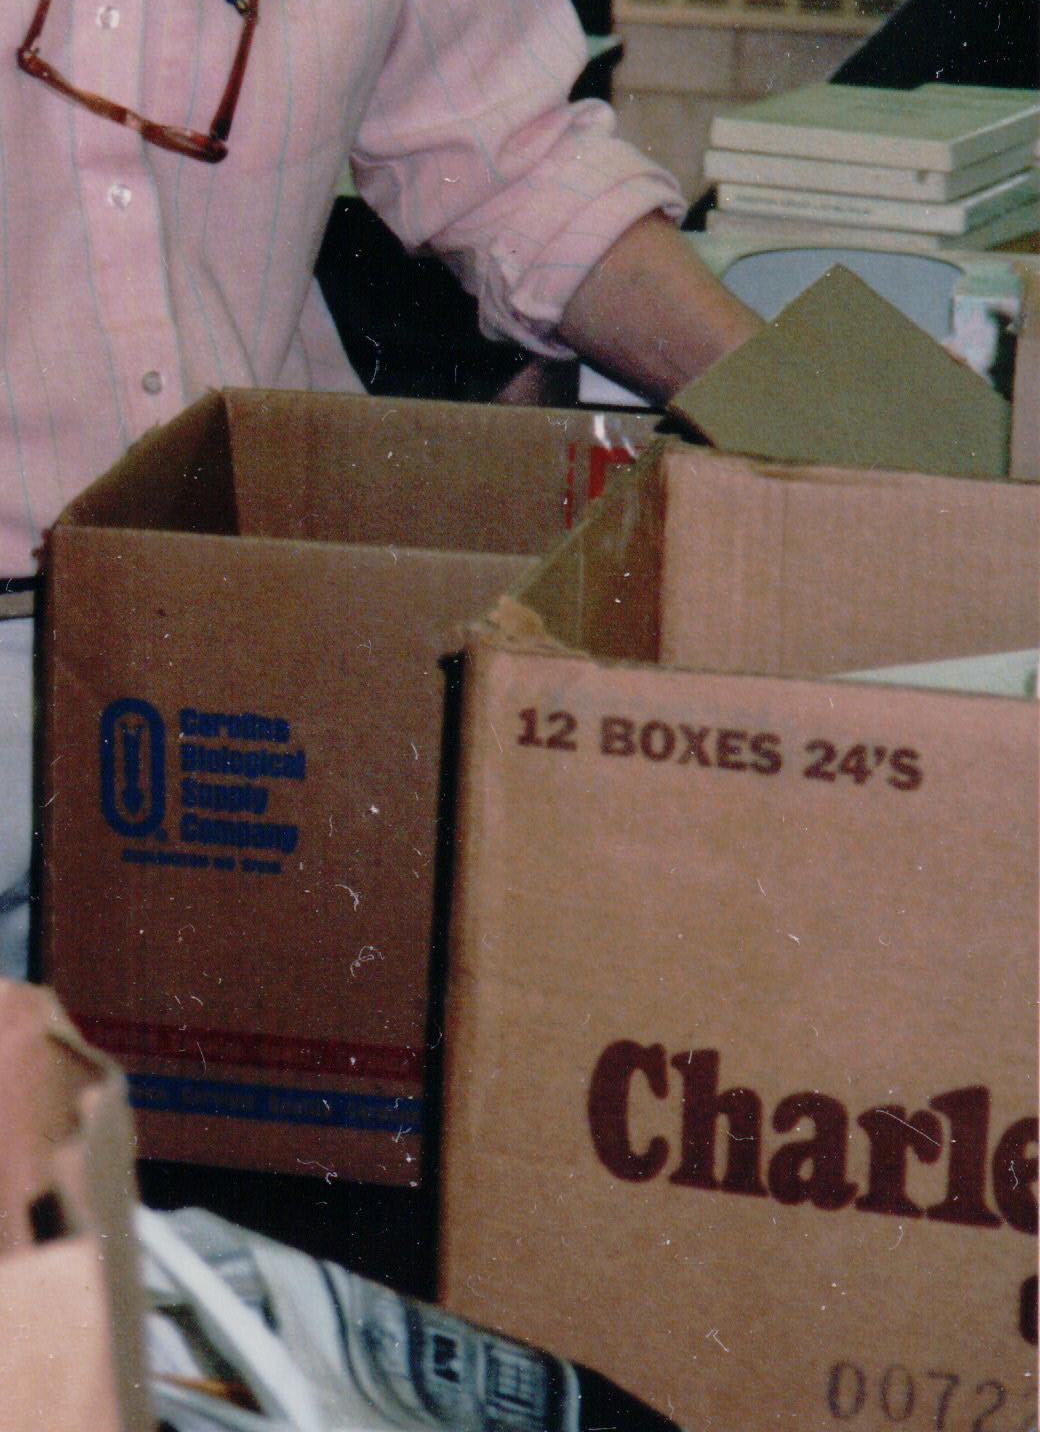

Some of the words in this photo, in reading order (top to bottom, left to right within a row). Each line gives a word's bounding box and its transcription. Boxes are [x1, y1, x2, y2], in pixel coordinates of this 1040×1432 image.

[179, 742, 306, 781] Biological
[516, 707, 578, 751] 12
[600, 716, 783, 776] BOXES
[803, 739, 924, 792] 24'S
[180, 777, 269, 815] Supply
[180, 812, 299, 855] Company
